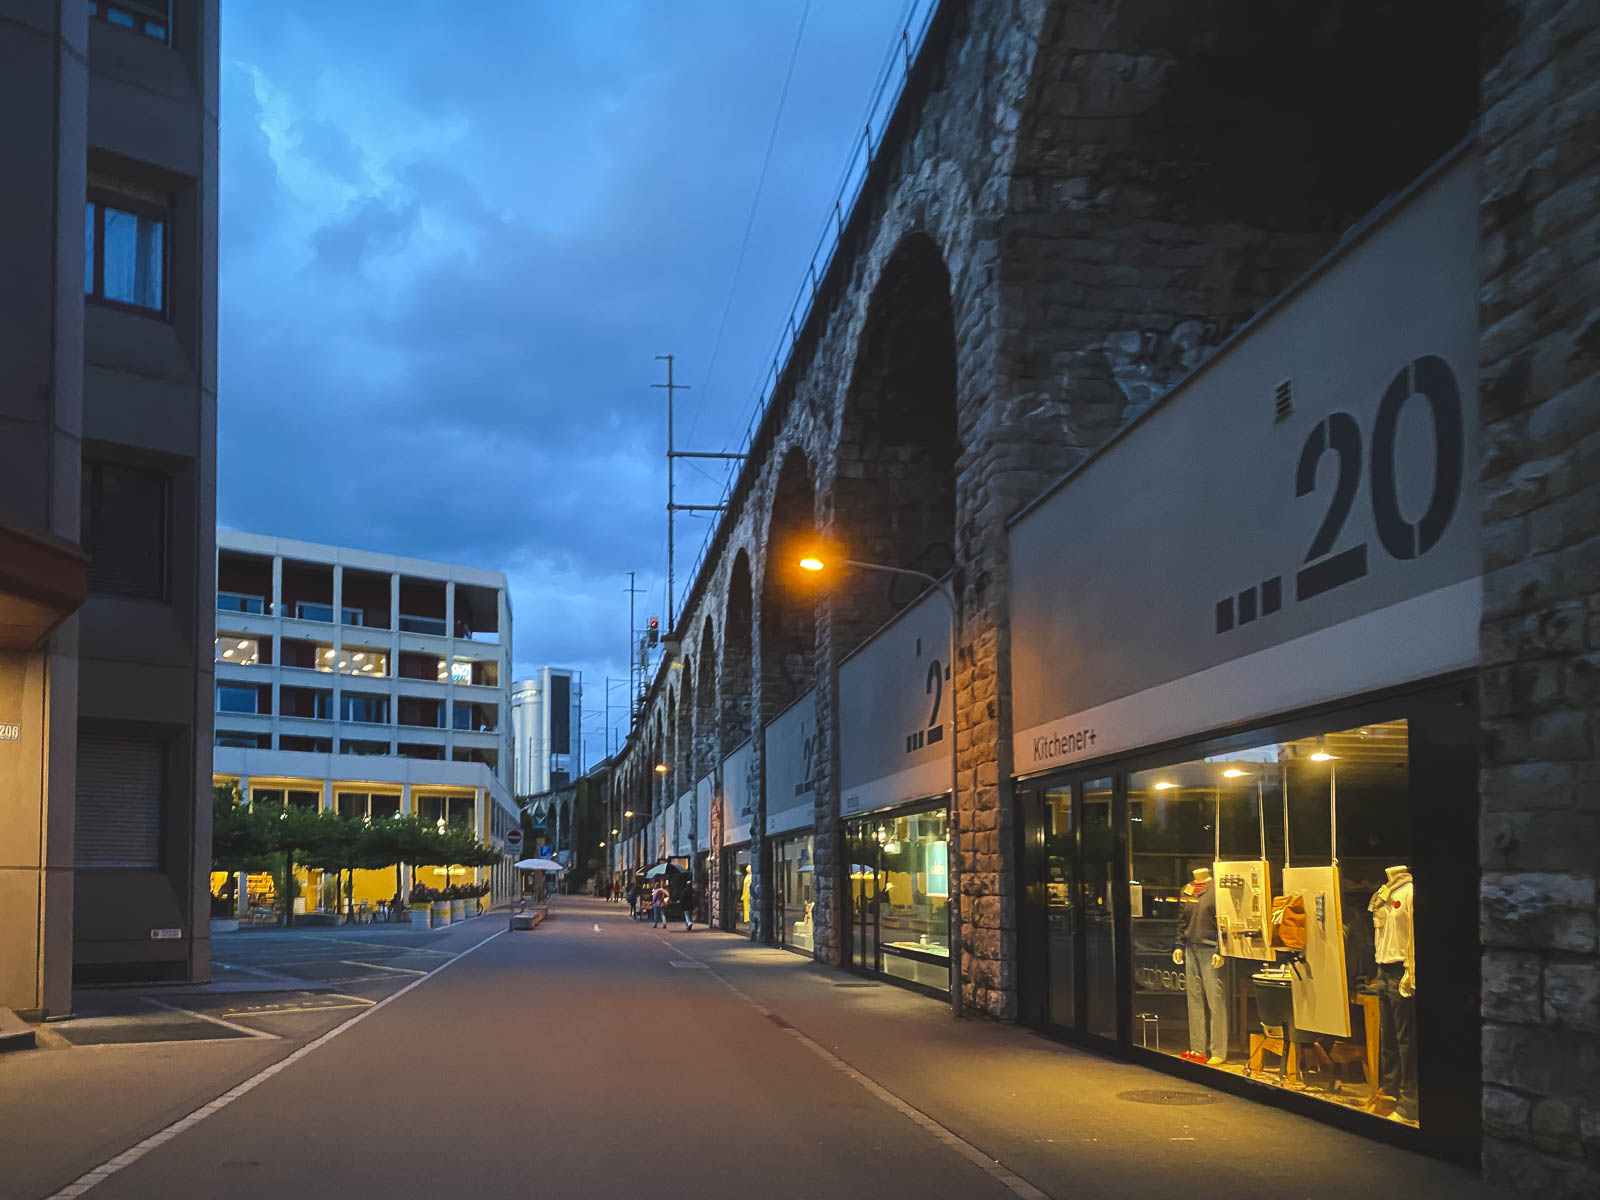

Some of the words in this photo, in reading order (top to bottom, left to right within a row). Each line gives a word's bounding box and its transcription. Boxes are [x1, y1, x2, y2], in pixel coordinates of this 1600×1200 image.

[1295, 354, 1464, 601] 20
[926, 659, 951, 746] 2
[1033, 728, 1097, 761] Kitchener+
